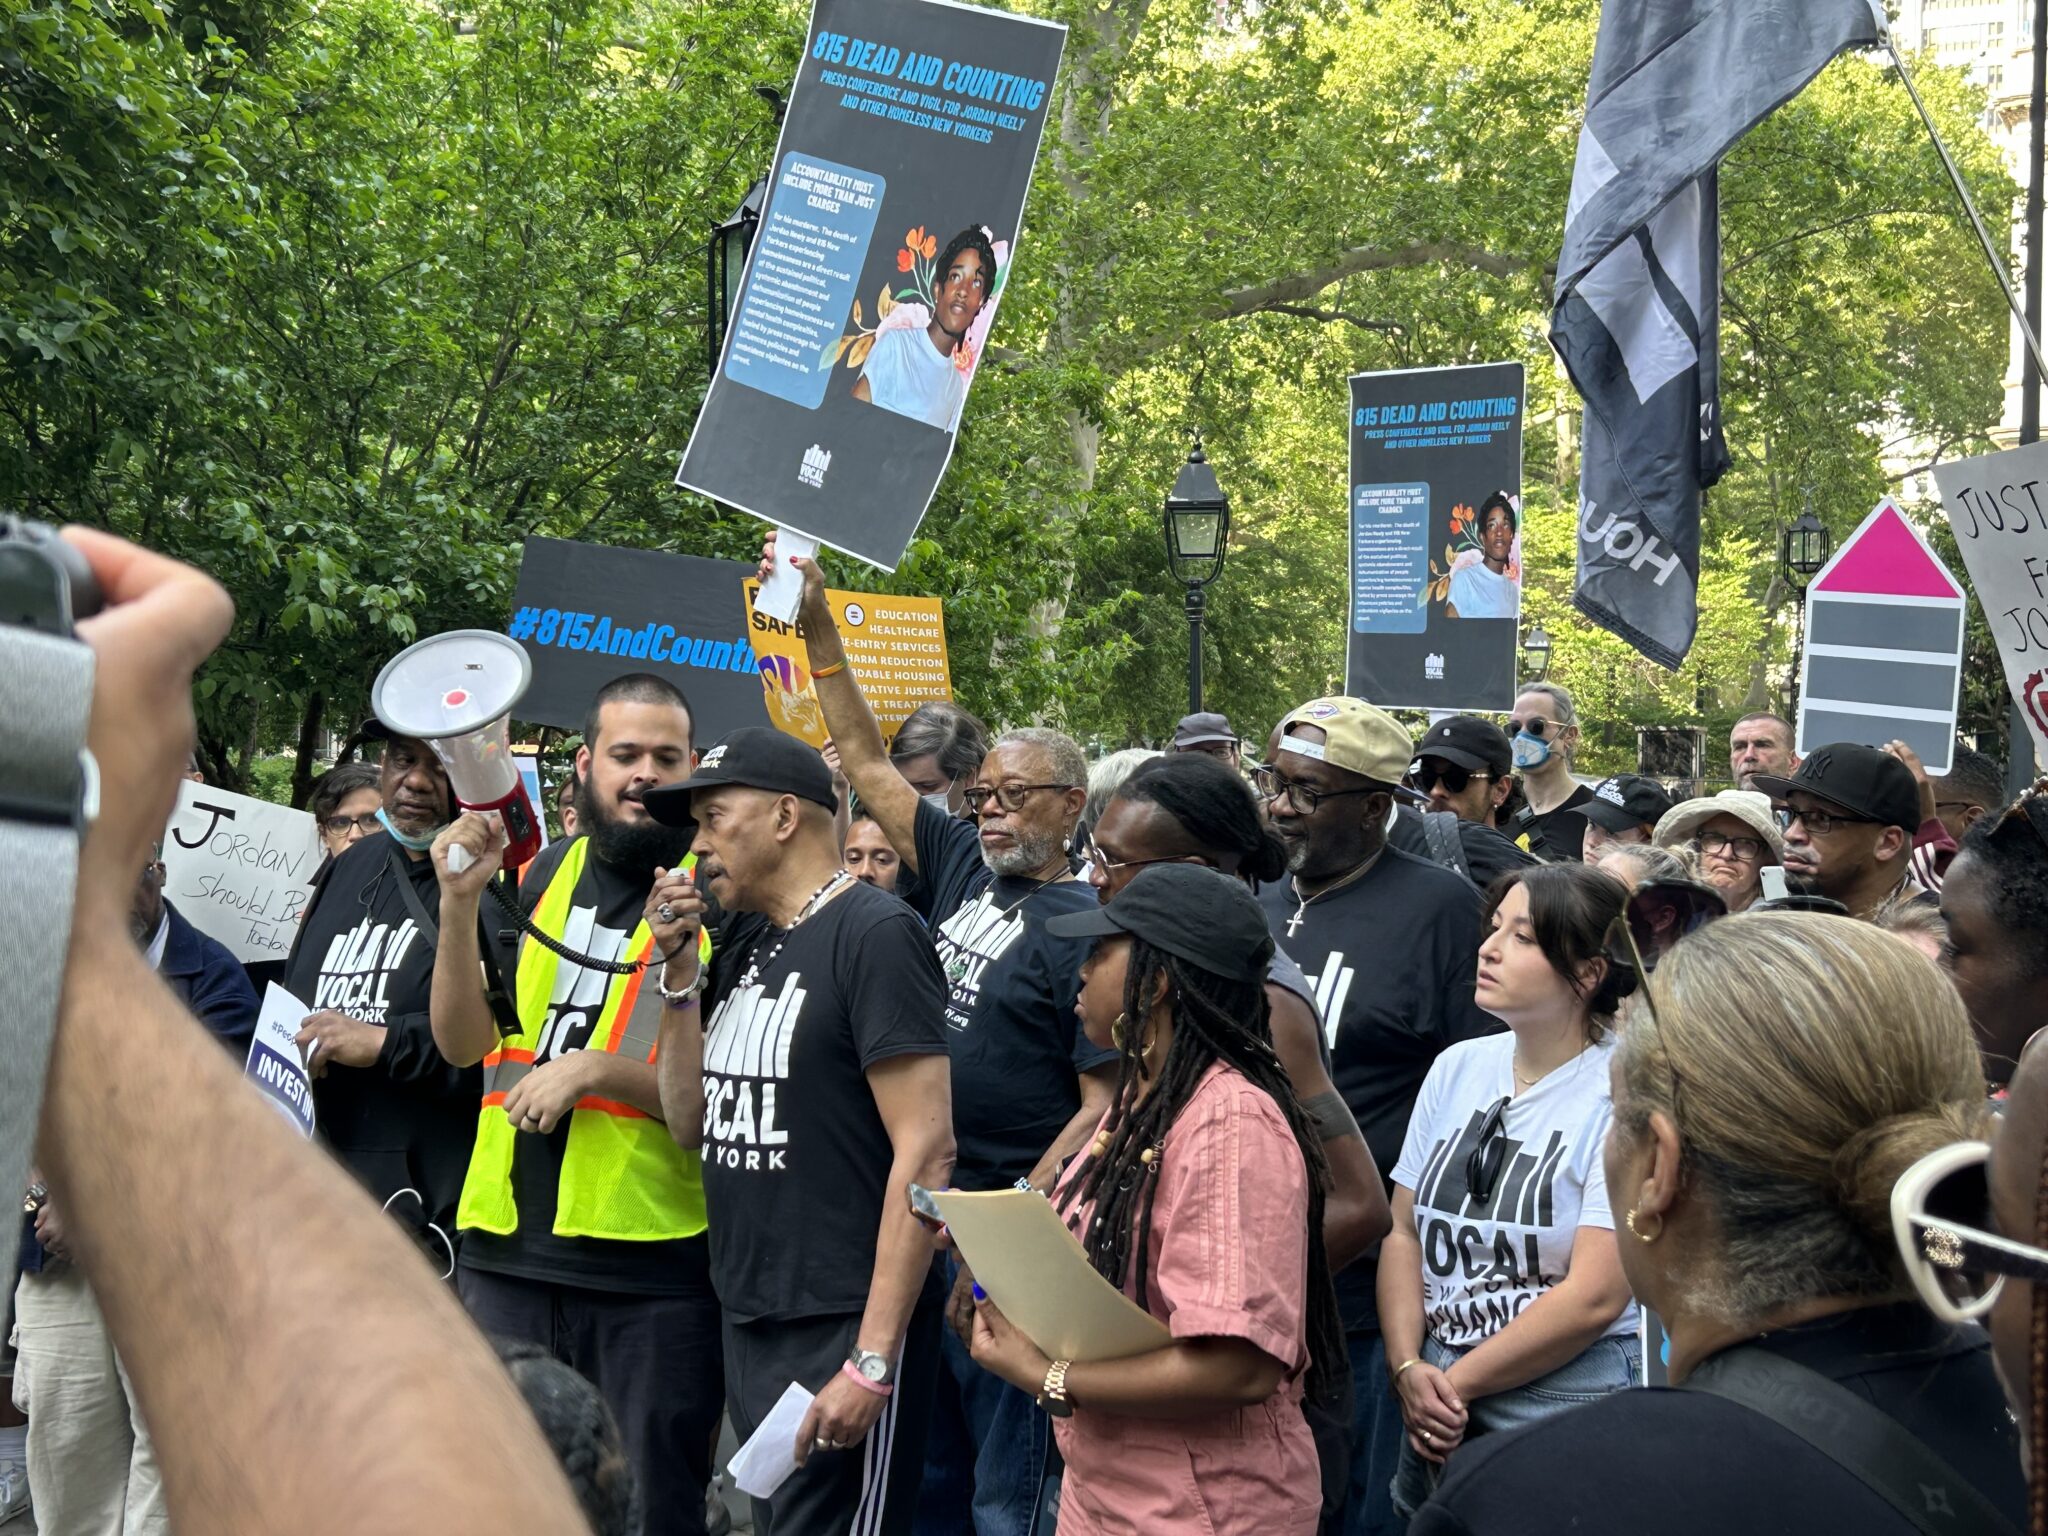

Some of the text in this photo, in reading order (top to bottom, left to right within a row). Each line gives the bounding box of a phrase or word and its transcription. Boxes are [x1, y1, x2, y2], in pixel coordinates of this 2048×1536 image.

[812, 31, 1045, 111] 815 DEAD AND COUNTING
[820, 70, 1026, 131] PRESS CONFERENCE AND VIGIL FOR JORDAN NEELY
[840, 94, 993, 143] AND OTHER HOMELESS NEW YORKERS
[791, 162, 874, 194] ACCOUNTABILITY MUST
[807, 195, 840, 214] CHARGES
[1355, 396, 1517, 426] 815 DEAD AND COUNTING
[1364, 429, 1384, 439] PRESS
[1956, 480, 2048, 539] JUST
[875, 609, 937, 622] EDUCATION
[509, 606, 759, 675] #815AndCounti
[870, 625, 939, 638] HEALTHCARE
[845, 653, 943, 667] HARM REDUCTION
[891, 642, 941, 652] SERVICES
[851, 668, 944, 681] RDABLE HOUSING
[858, 684, 946, 696] RATIVE JUSTICE
[883, 700, 923, 712] TREAT
[313, 972, 389, 1008] VOCAL
[951, 989, 977, 1006] ORK
[272, 1021, 297, 1047] #Peop
[257, 1053, 313, 1122] INVEST IN
[702, 1076, 788, 1145] OCAL
[716, 1144, 787, 1171] YORK
[1417, 1214, 1540, 1280] OCAL
[1424, 1282, 1455, 1302] EW
